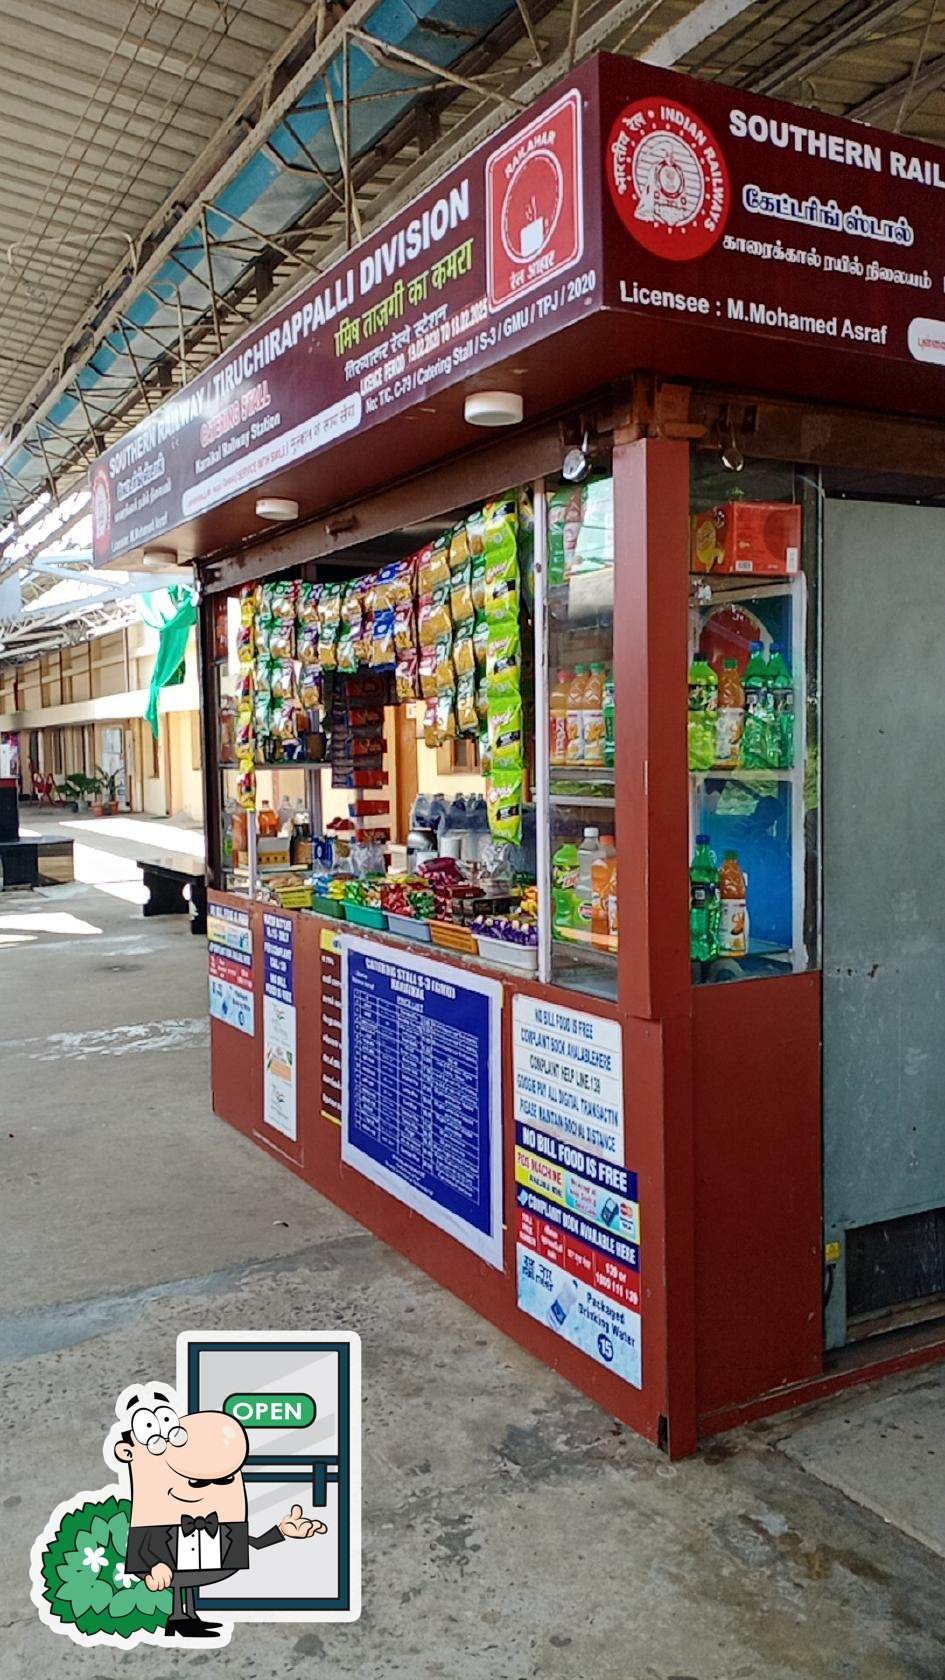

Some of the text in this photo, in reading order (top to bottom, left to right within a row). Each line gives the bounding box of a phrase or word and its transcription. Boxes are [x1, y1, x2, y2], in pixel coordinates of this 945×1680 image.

[661, 106, 724, 232] INDIAN RAILWAYS
[729, 109, 882, 172] SOUTHERN
[744, 185, 913, 245] கேட்டரிங் ஸ்டால்
[407, 270, 429, 306] का
[431, 238, 474, 290] कमरा
[723, 235, 822, 267] காரைக்கால்
[109, 426, 157, 478] SOUTHERN
[157, 387, 205, 446] RAILWAY
[212, 269, 354, 400] TIRUCHIRAPPALLI
[360, 179, 469, 295] DIVISION
[417, 354, 452, 386] Catering
[453, 340, 473, 365] Stall
[480, 326, 496, 350] S-3
[503, 306, 528, 336] GMU
[536, 290, 558, 318] TPJ
[567, 270, 596, 302] 2020
[619, 280, 709, 314] Licensee
[727, 298, 837, 336] M.Mohamed
[841, 319, 887, 344] Asraf
[251, 413, 281, 439] Station
[578, 1021, 593, 1040] FREE
[522, 1125, 628, 1193] NO BILL FOOD IS FREE
[578, 1302, 635, 1348] Drinking Water
[586, 1292, 625, 1325] Packaged
